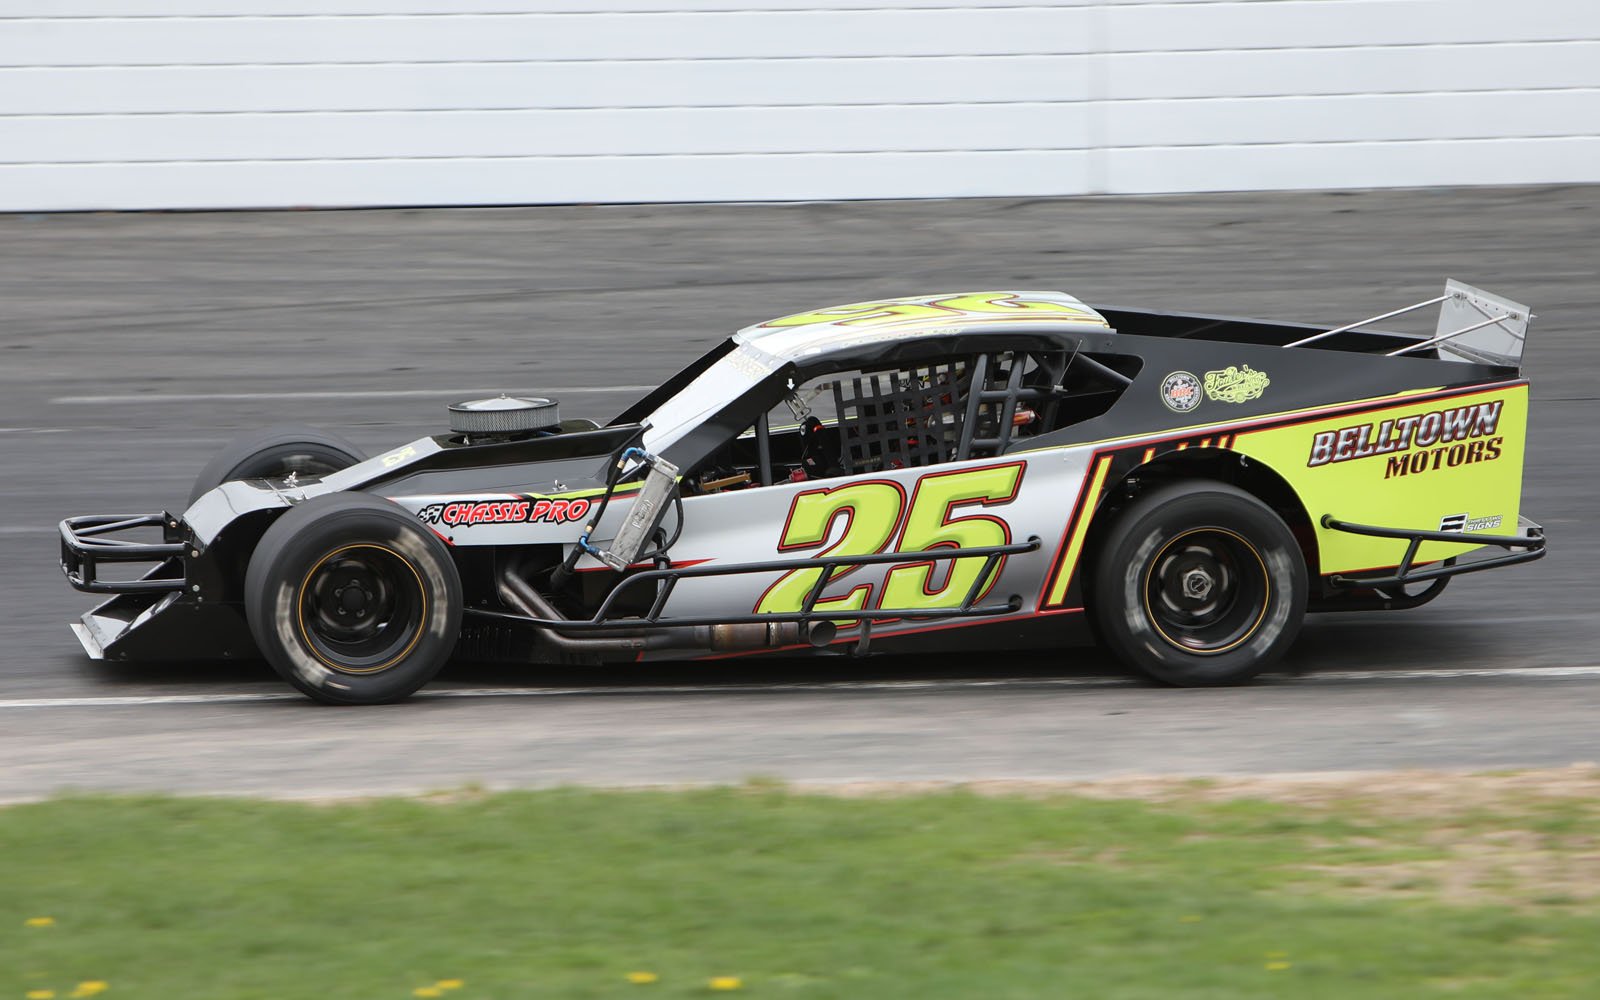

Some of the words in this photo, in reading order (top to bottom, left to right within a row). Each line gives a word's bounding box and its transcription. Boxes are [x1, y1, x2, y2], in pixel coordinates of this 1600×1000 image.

[1307, 400, 1504, 468] BELLTOWN
[1384, 437, 1503, 479] MOTORS
[442, 501, 528, 525] CHASSIS
[531, 499, 591, 524] PRO
[1467, 520, 1502, 532] SIGNS
[752, 460, 1027, 629] 25
